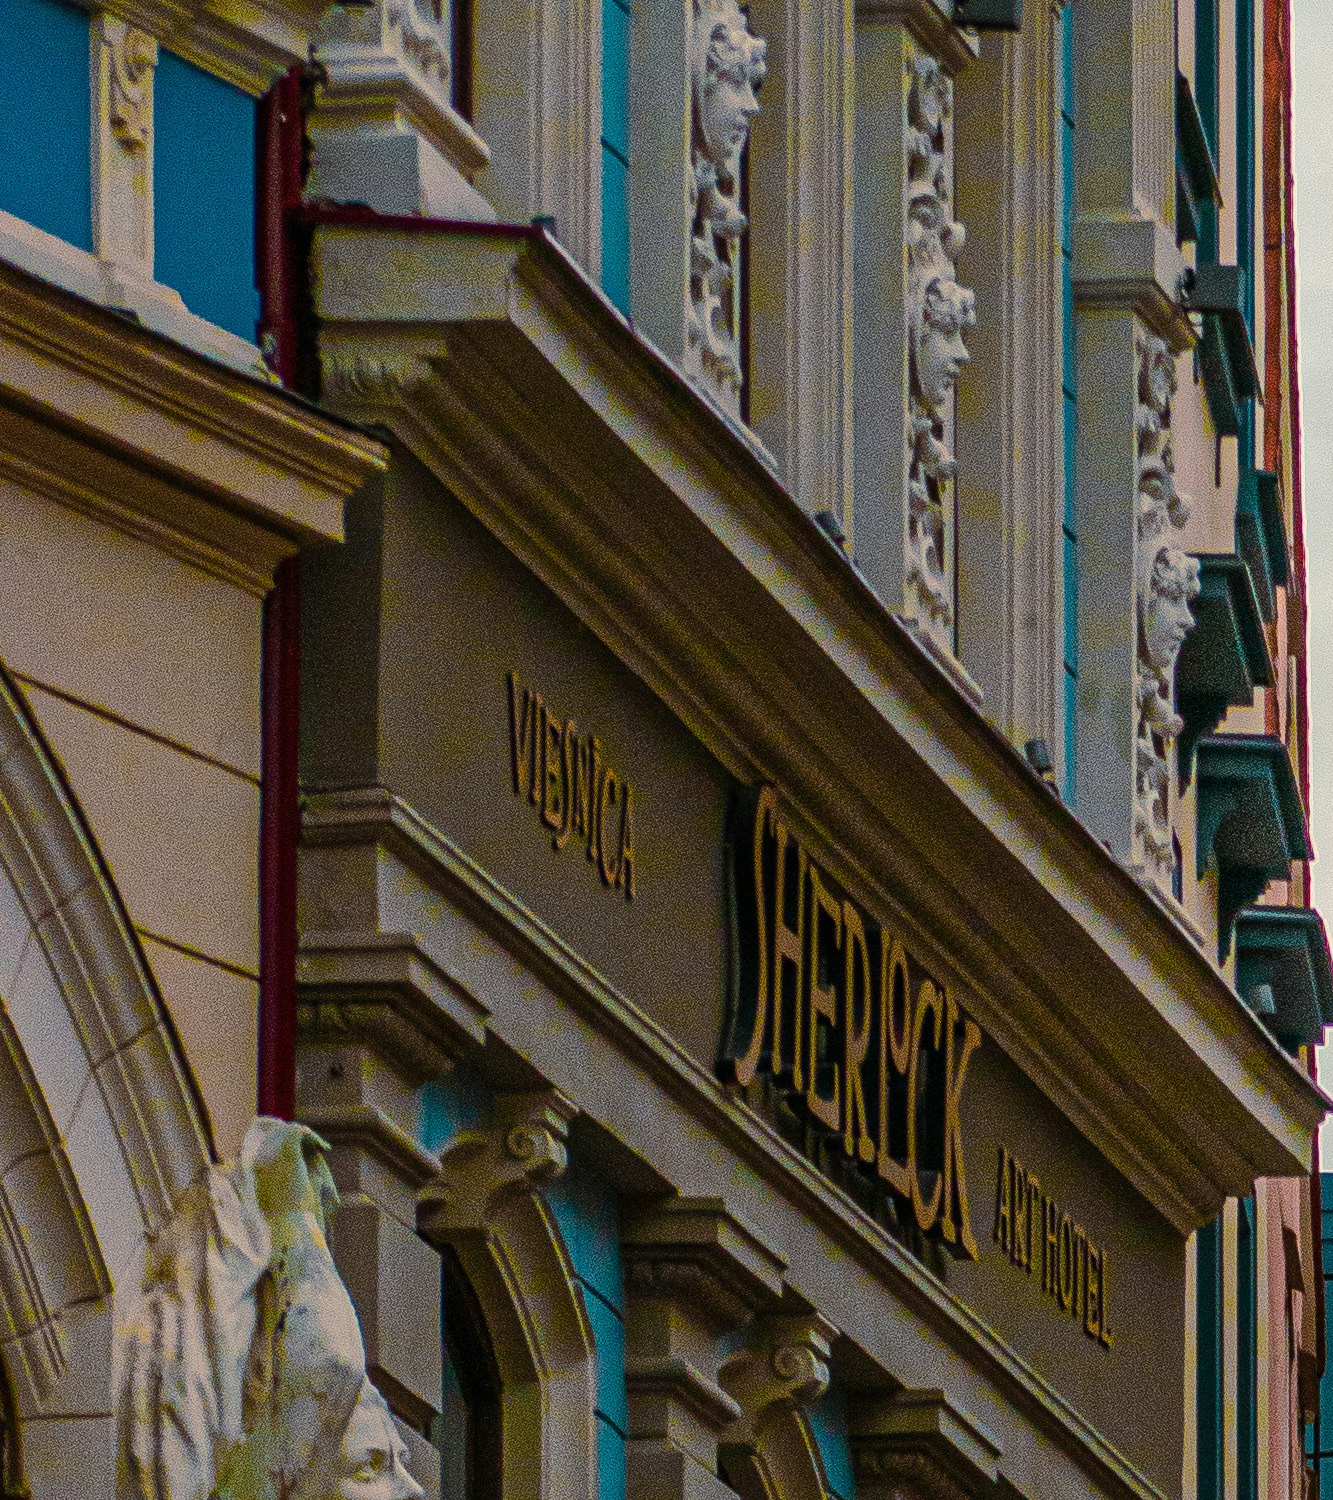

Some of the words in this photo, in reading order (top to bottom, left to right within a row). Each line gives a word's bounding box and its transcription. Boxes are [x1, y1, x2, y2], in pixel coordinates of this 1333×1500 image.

[735, 785, 981, 1262] SHERLOCK
[992, 1146, 1040, 1275] ART
[1041, 1194, 1114, 1352] HOTEL
